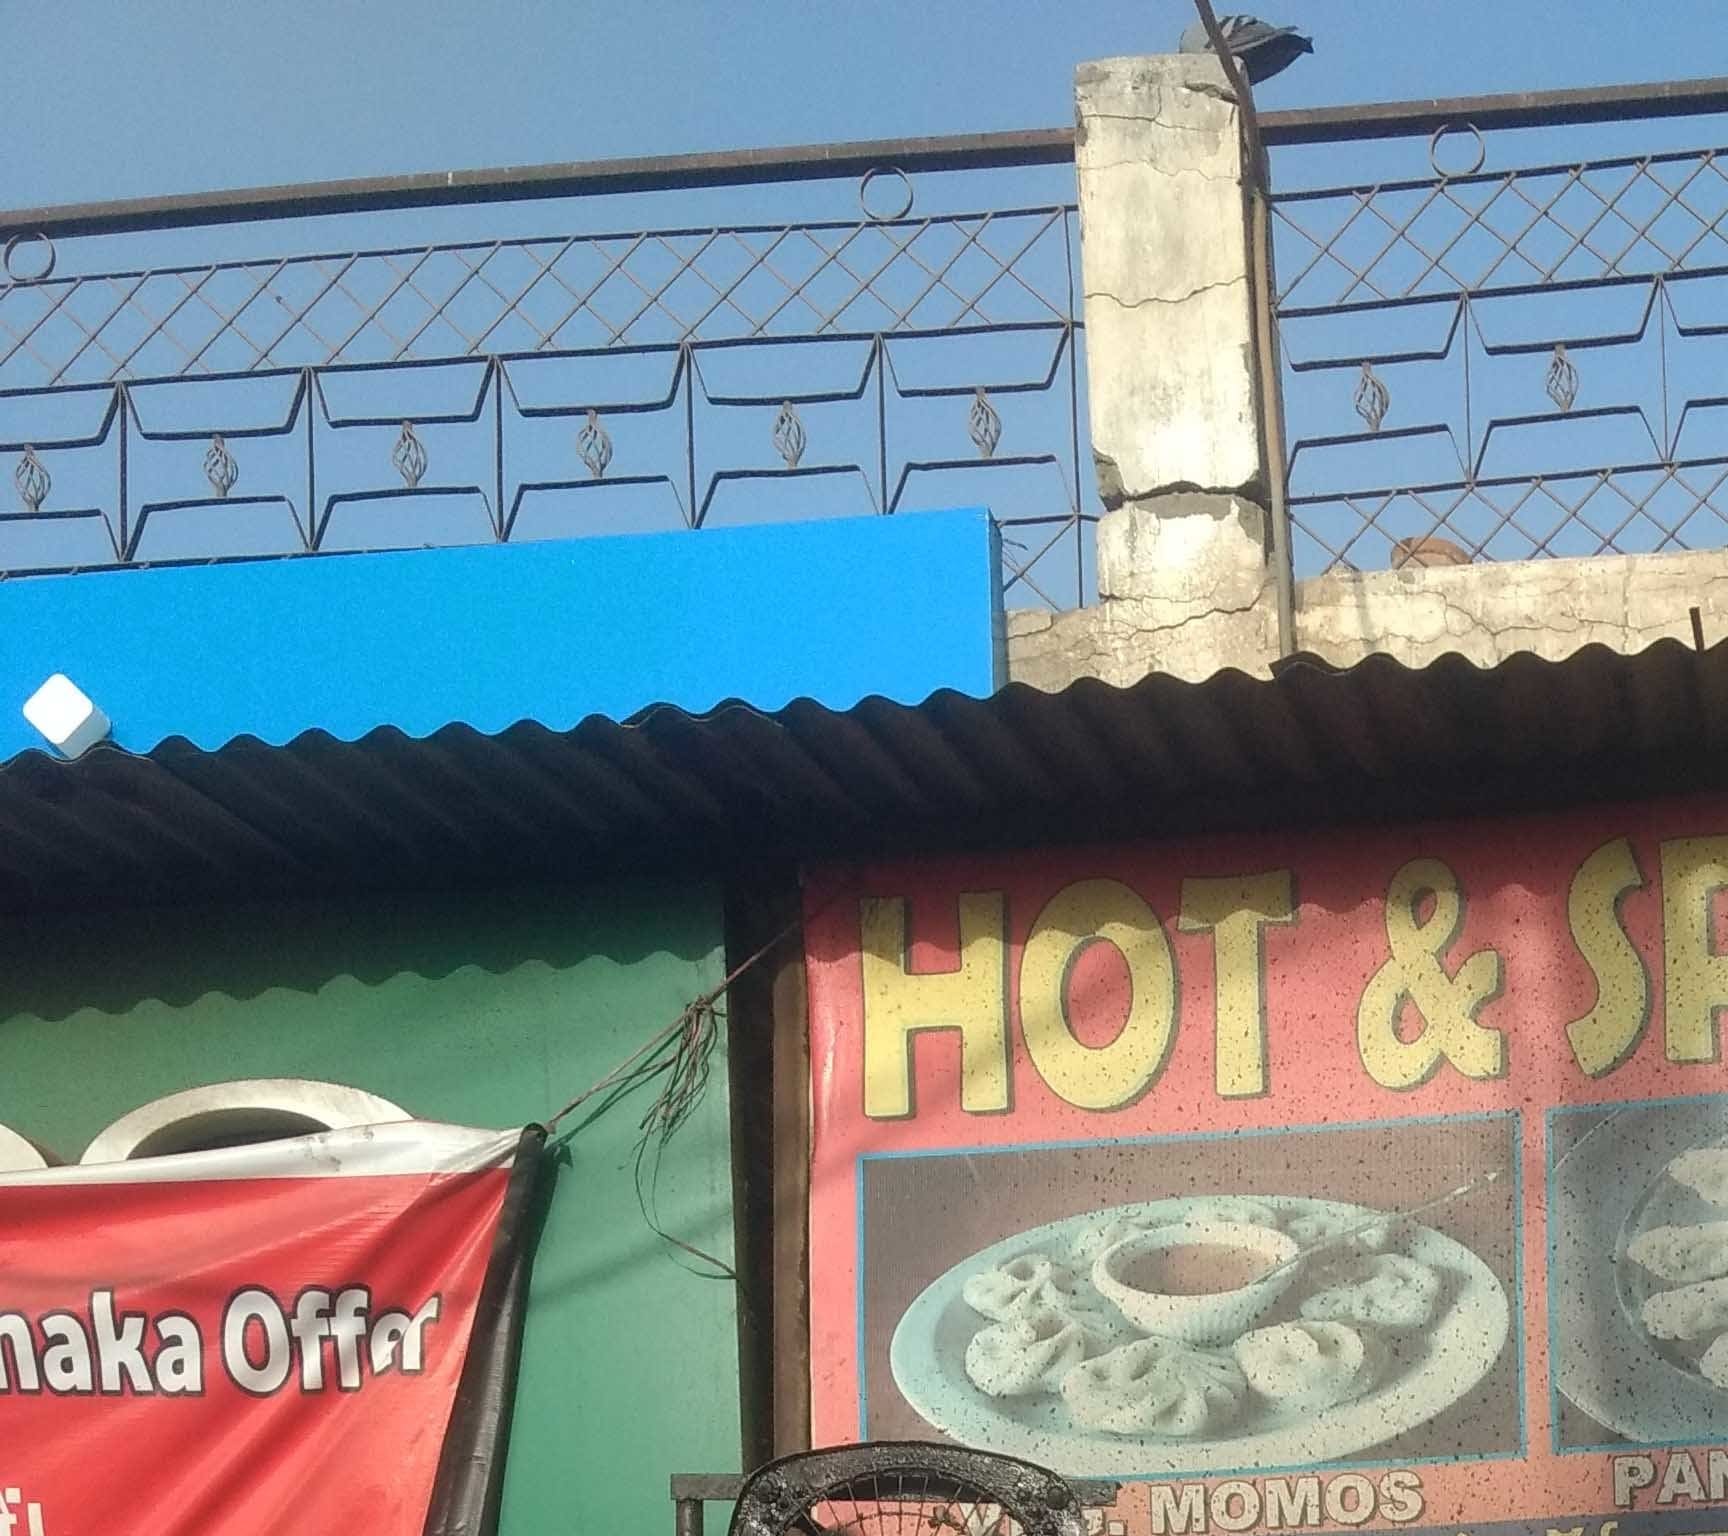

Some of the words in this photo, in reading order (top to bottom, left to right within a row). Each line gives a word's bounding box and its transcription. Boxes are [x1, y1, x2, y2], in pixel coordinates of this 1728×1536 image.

[859, 868, 1303, 1121] HOT
[1356, 857, 1507, 1095] &
[221, 1283, 442, 1395] Offer
